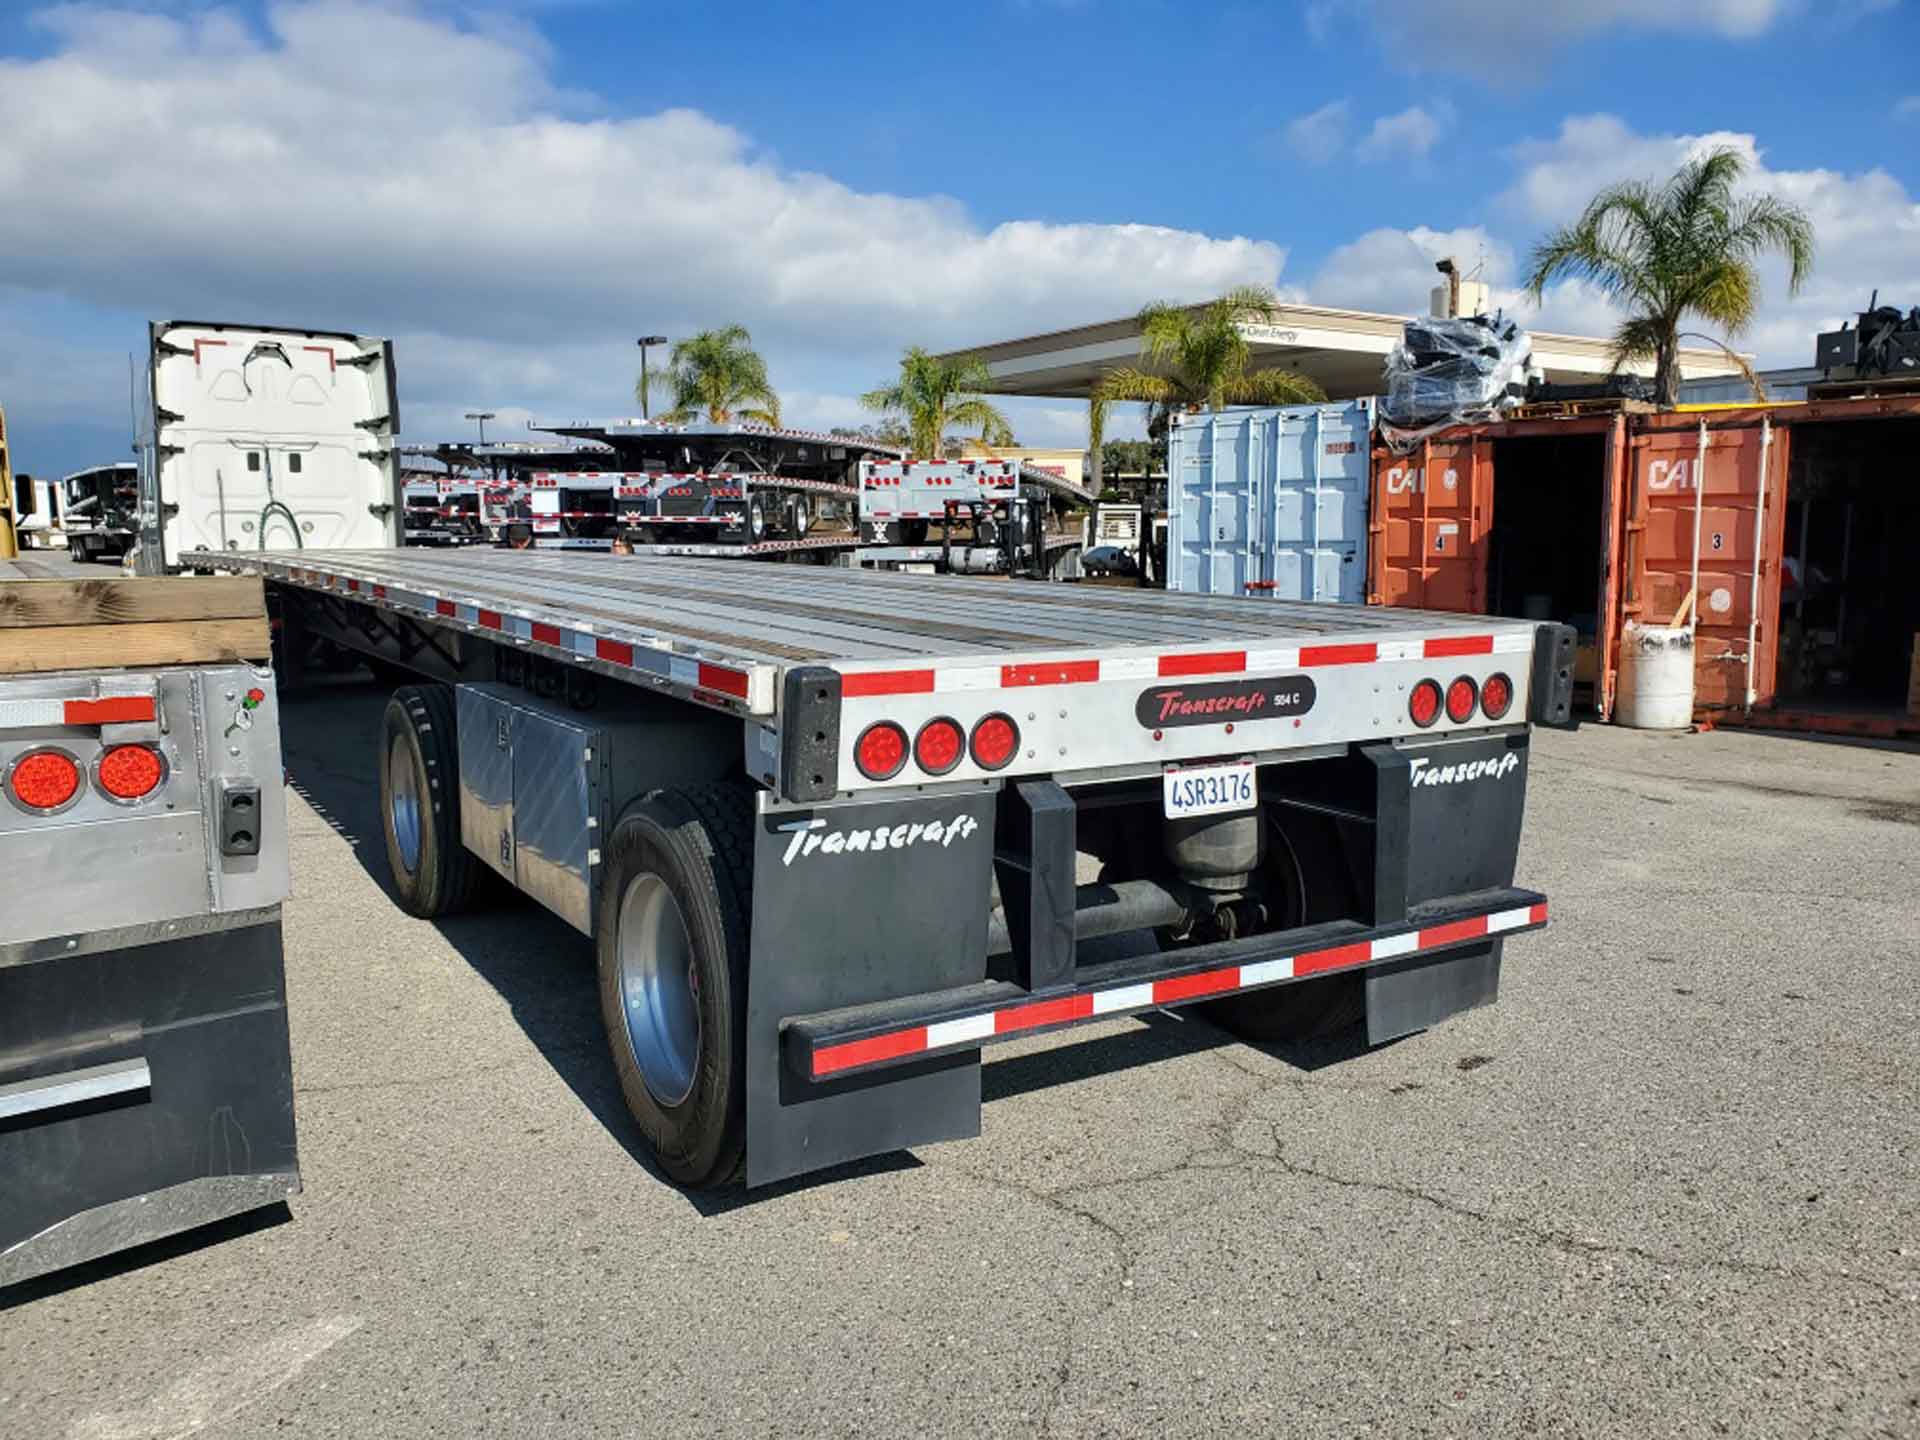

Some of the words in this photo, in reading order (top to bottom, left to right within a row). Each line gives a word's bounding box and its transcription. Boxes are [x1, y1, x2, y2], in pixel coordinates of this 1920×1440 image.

[1713, 533, 1721, 549] 3
[1156, 691, 1265, 721] Transcraft
[1292, 692, 1300, 704] C
[1409, 751, 1519, 788] Transcraft
[1171, 772, 1251, 808] 4SR3176
[777, 814, 978, 867] Transcraft
